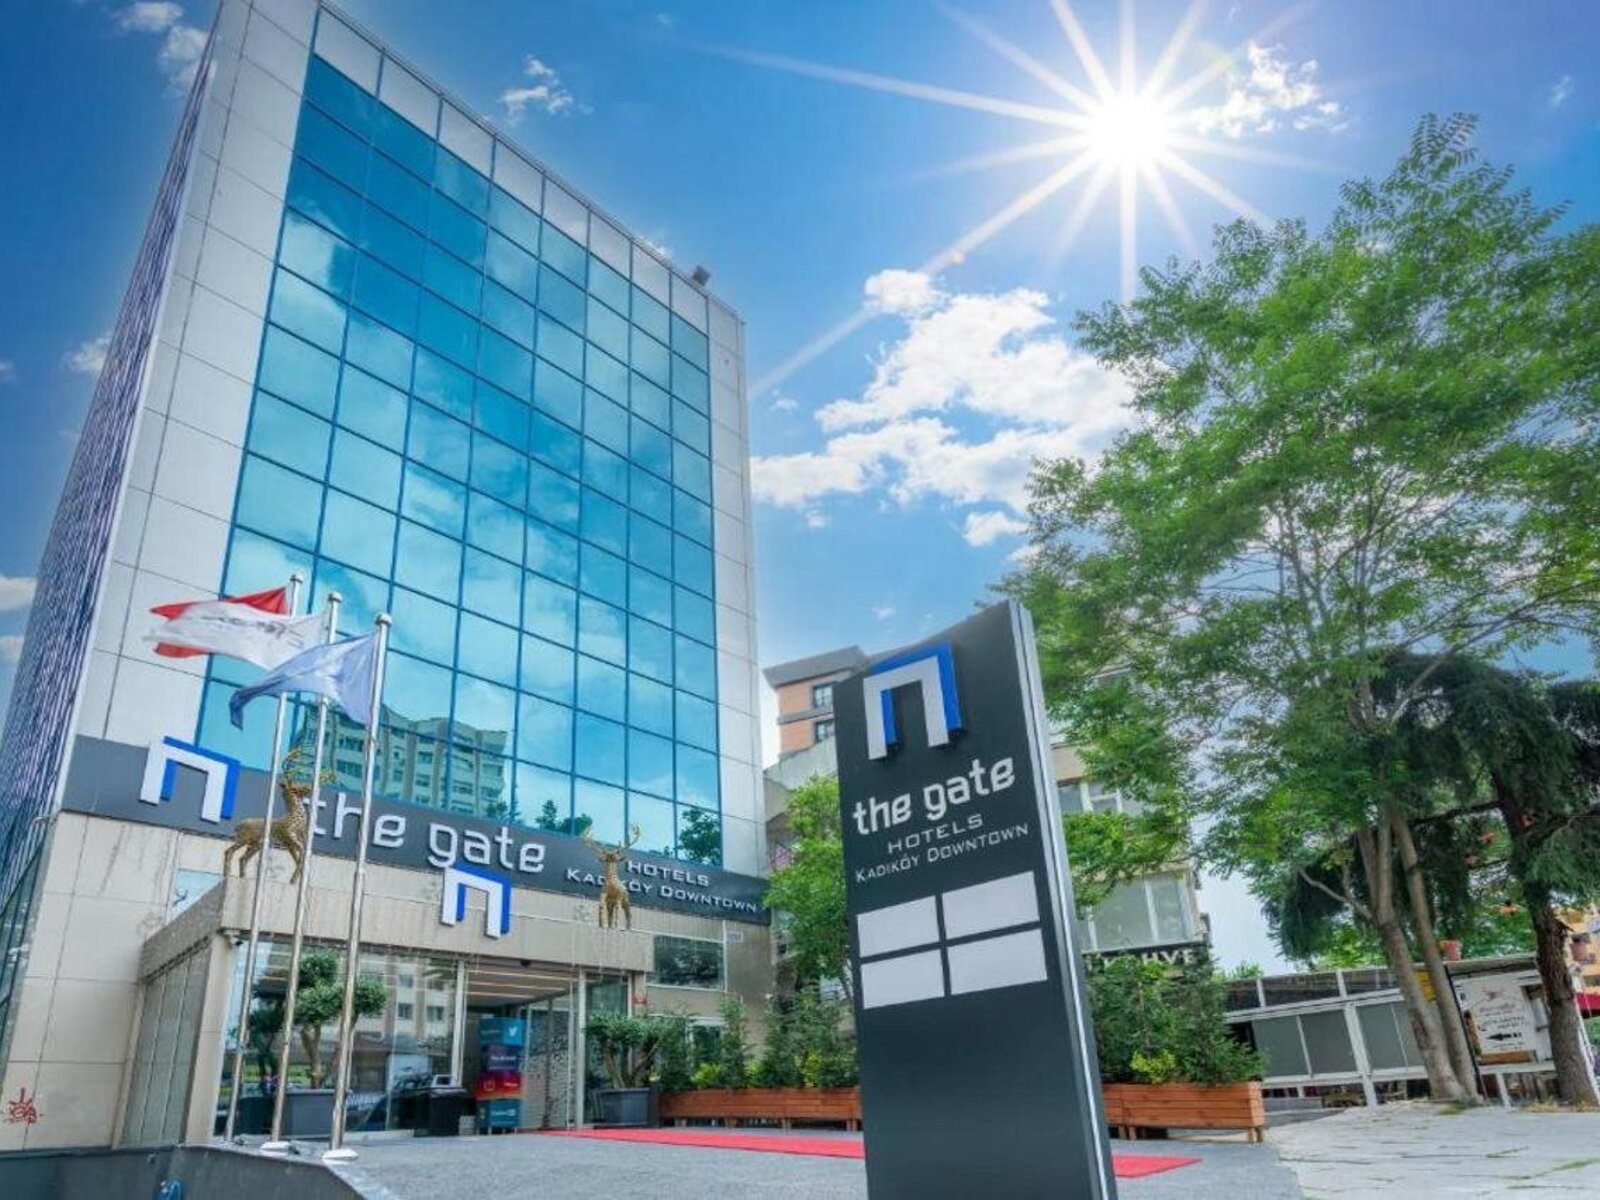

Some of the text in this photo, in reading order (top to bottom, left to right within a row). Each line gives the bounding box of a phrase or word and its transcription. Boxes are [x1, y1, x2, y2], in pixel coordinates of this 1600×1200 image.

[852, 757, 1016, 835] the gate
[303, 792, 546, 873] the gate
[887, 813, 983, 853] HOTELS
[927, 823, 1029, 862] DOWNTOWN
[627, 860, 710, 887] HOTELS
[660, 885, 757, 912] DOWNTOWN
